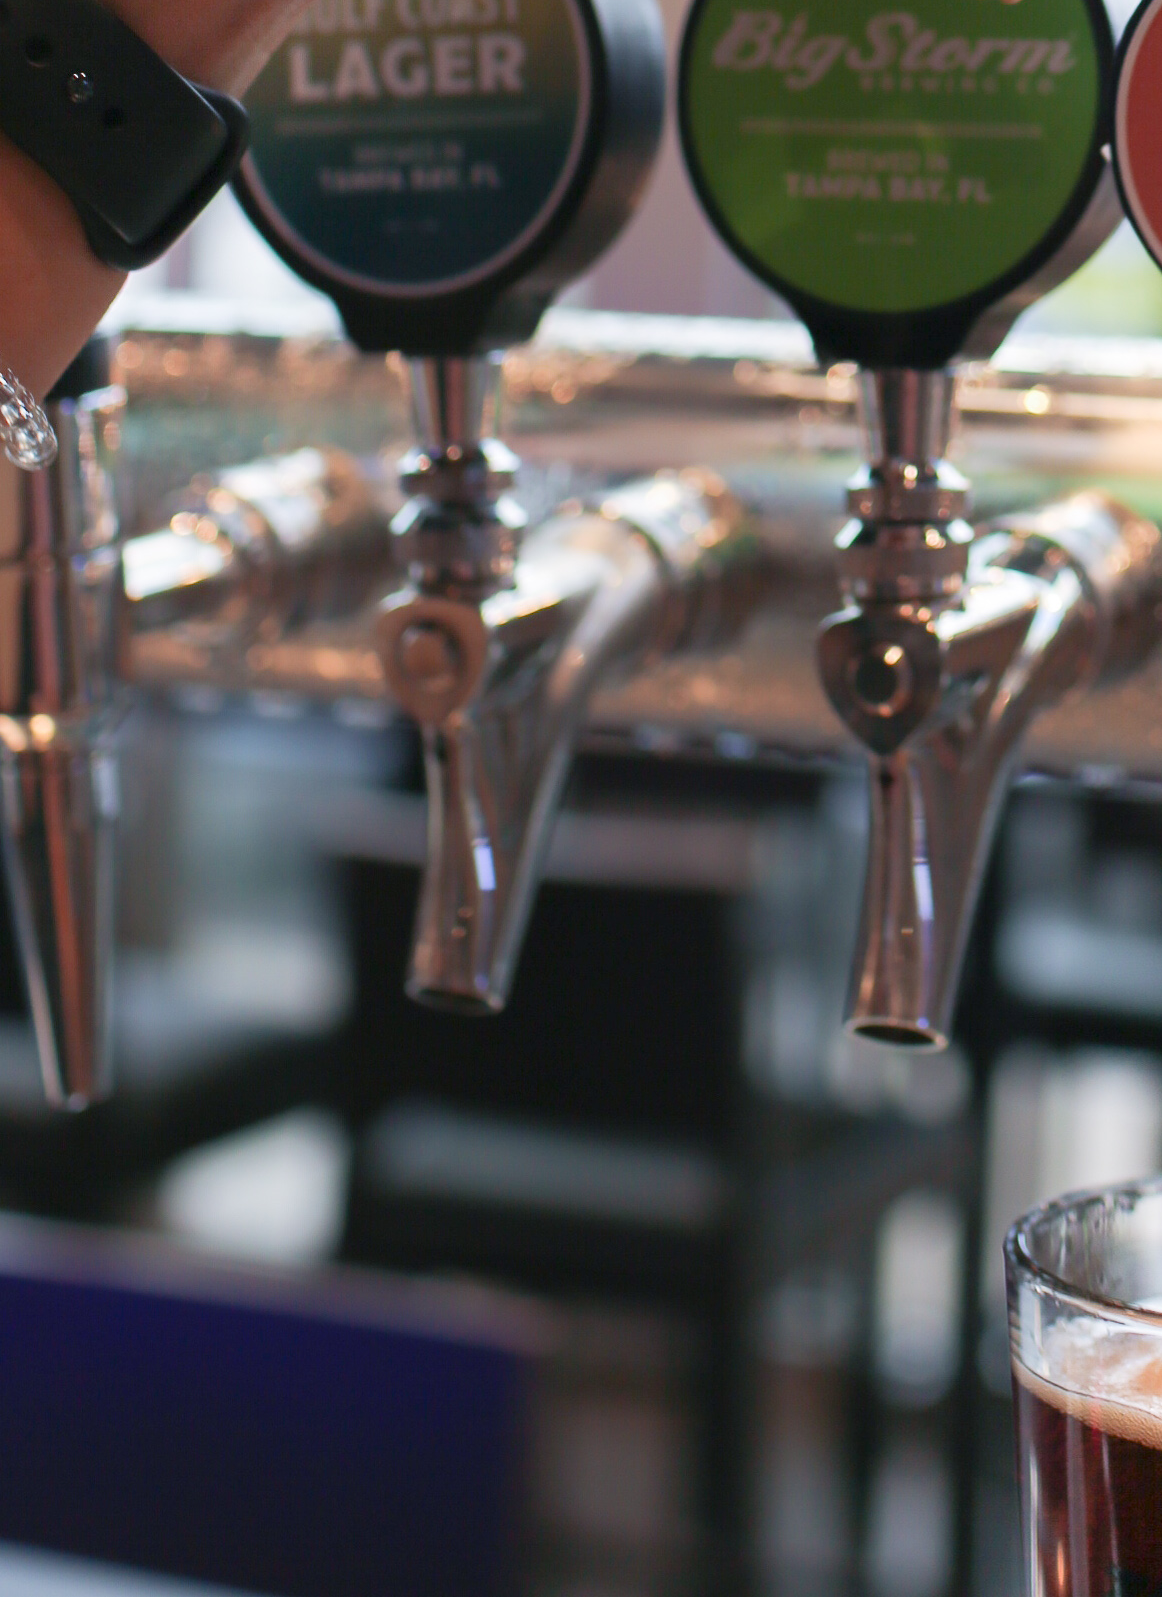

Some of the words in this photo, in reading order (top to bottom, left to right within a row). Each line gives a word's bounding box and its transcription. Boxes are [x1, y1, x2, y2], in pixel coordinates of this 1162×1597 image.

[288, 31, 528, 105] LAGER
[712, 6, 849, 90] Big
[845, 11, 1076, 75] Storm
